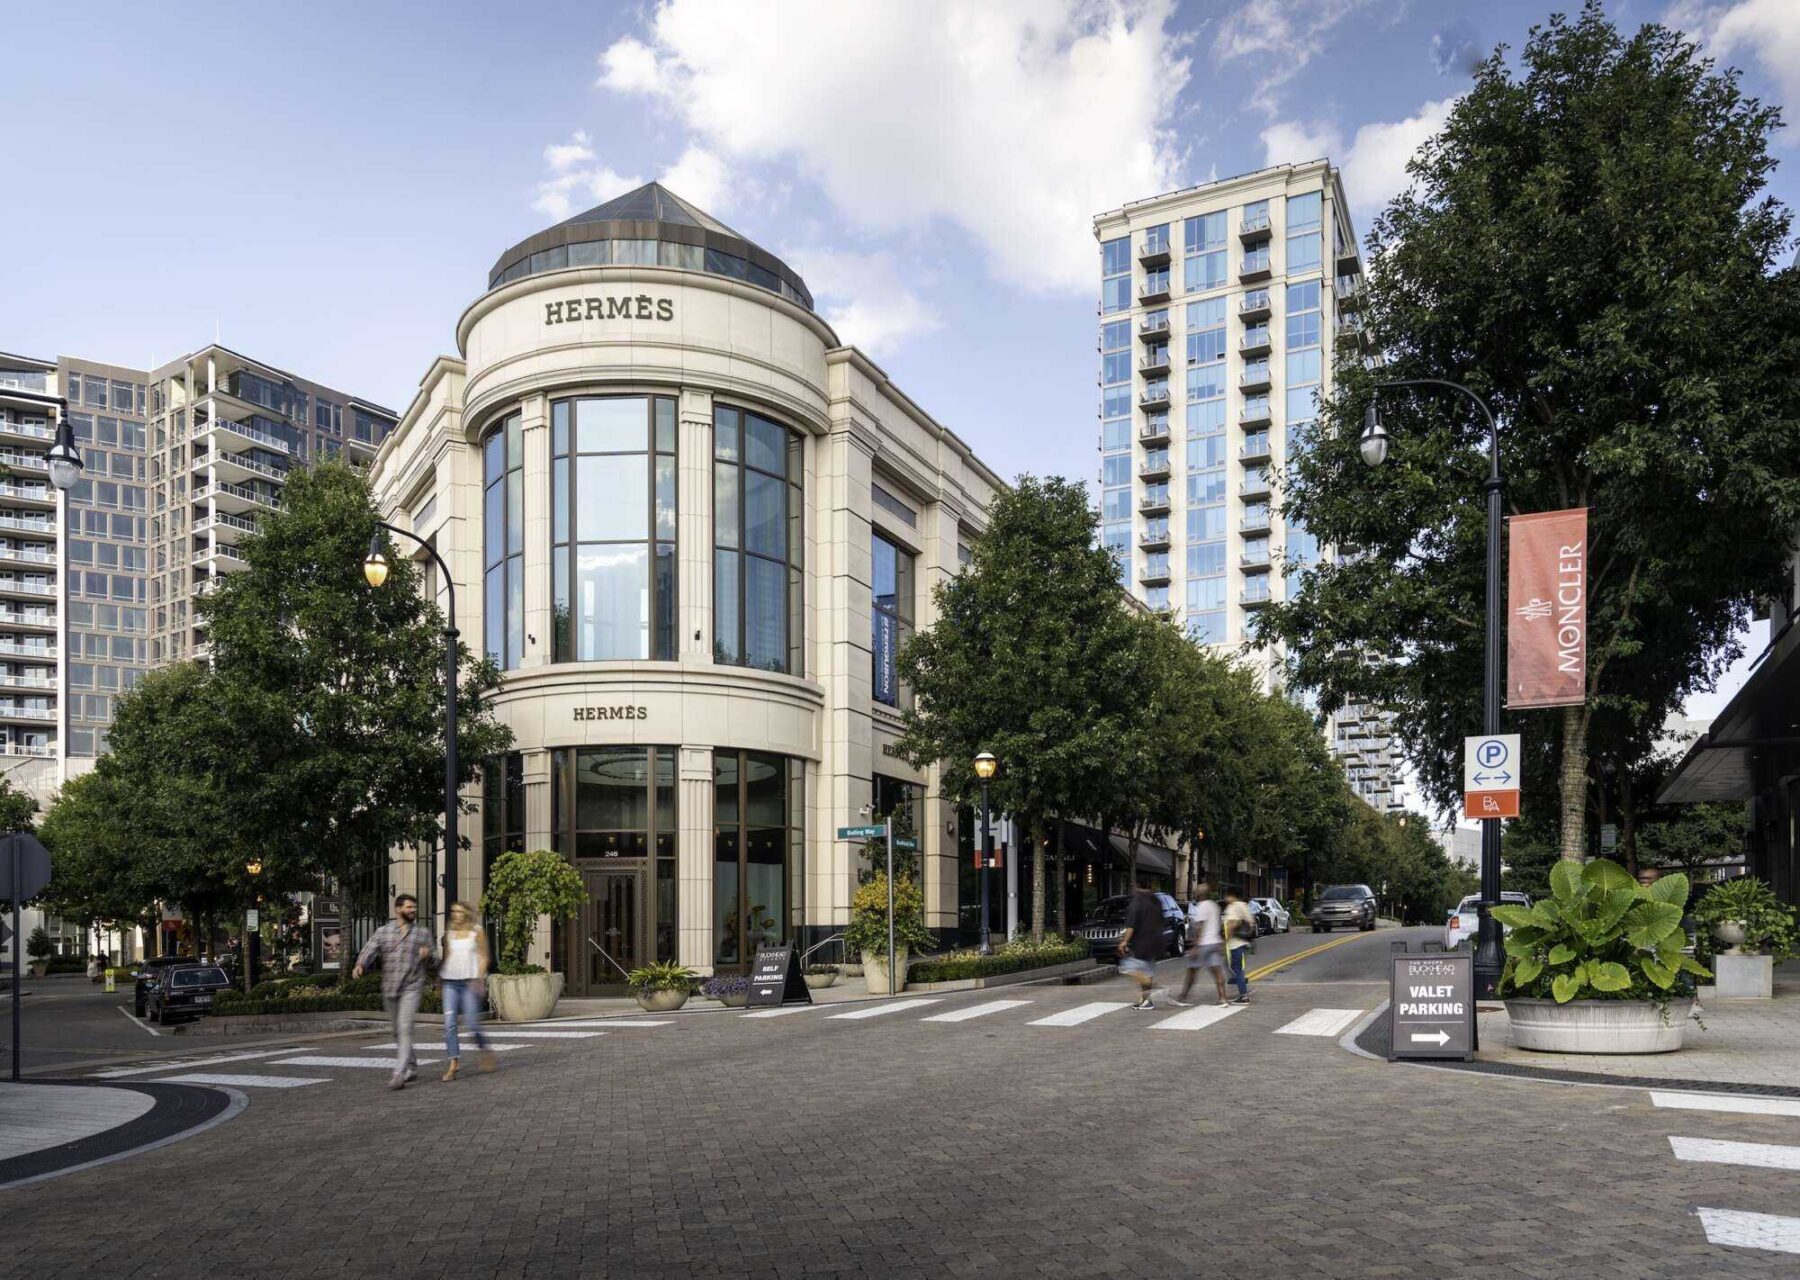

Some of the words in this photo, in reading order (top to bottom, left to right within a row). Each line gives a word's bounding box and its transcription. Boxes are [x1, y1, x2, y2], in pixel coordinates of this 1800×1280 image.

[545, 294, 673, 325] HERMÈS
[1558, 541, 1582, 672] MONCLER
[573, 705, 647, 721] HERMÈS
[1486, 746, 1501, 763] P
[1409, 964, 1455, 973] BUCKHEAD
[1409, 986, 1454, 998] VALET
[1400, 1003, 1464, 1015] PARKING
